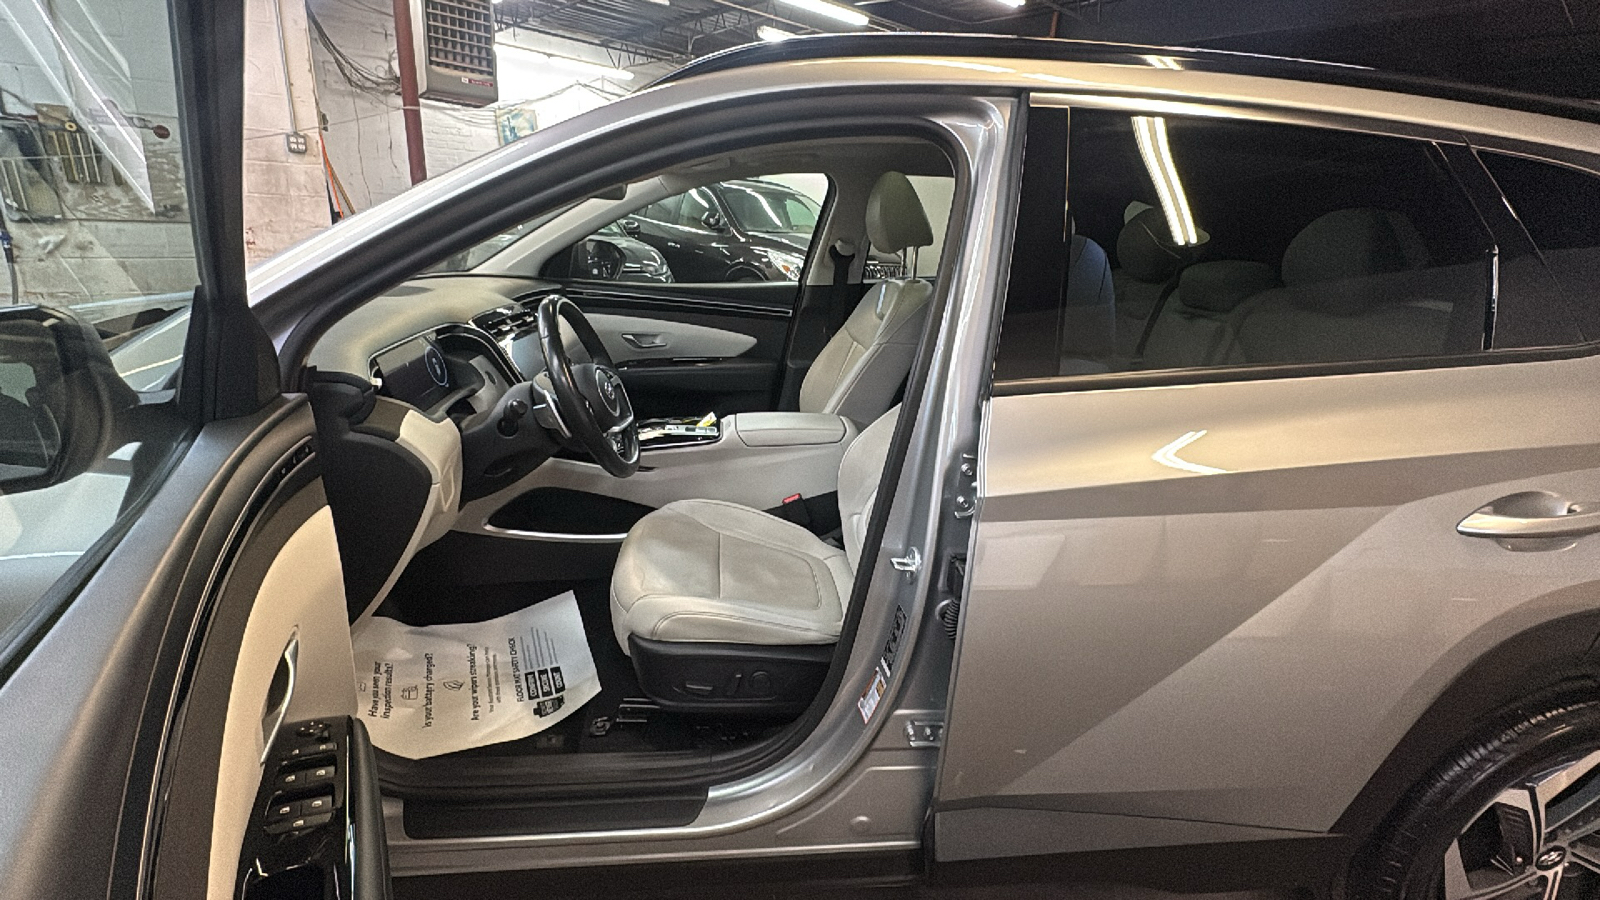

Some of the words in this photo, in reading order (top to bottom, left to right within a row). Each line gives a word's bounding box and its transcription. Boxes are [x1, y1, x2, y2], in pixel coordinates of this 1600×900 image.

[508, 637, 517, 655] CHECK
[423, 653, 435, 681] charged?
[422, 683, 435, 707] battery
[472, 695, 481, 709] your
[515, 684, 524, 702] FLOOR
[368, 700, 379, 717] Have
[471, 709, 480, 720] Are
